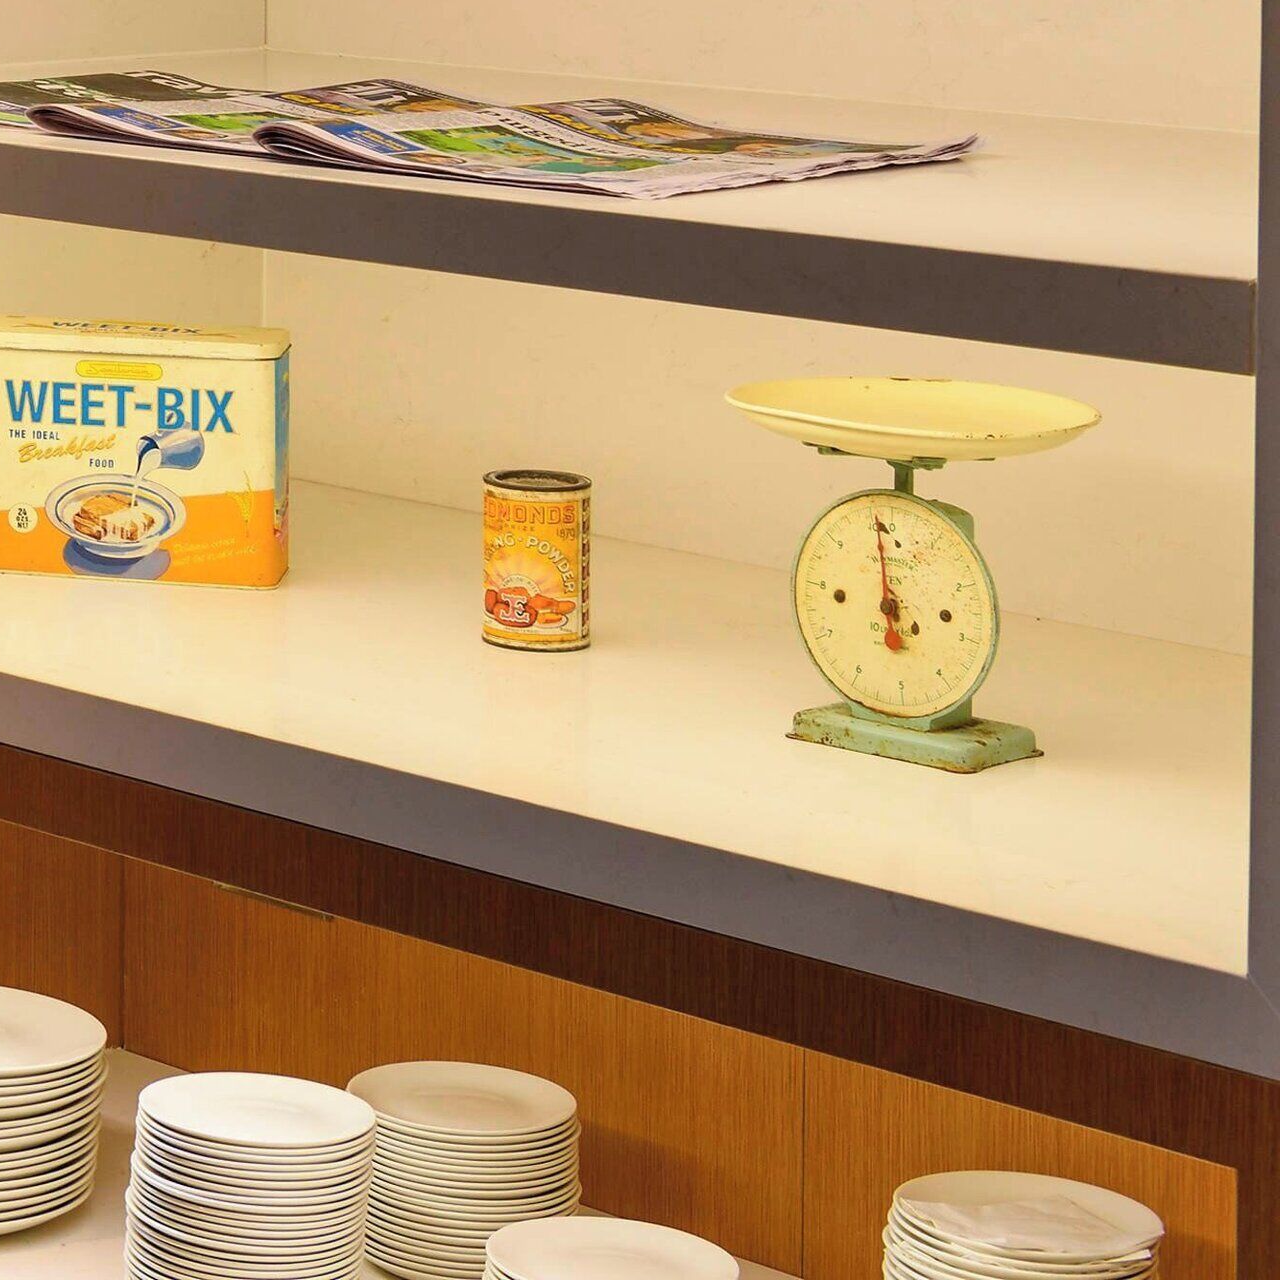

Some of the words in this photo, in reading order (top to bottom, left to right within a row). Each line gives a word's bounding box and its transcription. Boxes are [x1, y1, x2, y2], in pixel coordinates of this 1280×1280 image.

[5, 379, 235, 433] WEET-BIX
[9, 429, 26, 439] THE
[32, 430, 60, 440] IDEAL
[18, 434, 116, 463] Breakfast
[89, 458, 115, 469] FOOD
[526, 536, 575, 595] POWDER
[819, 580, 827, 590] 8
[956, 582, 963, 592] 2
[959, 632, 966, 642] 3
[855, 664, 863, 674] 6
[898, 680, 905, 690] 5
